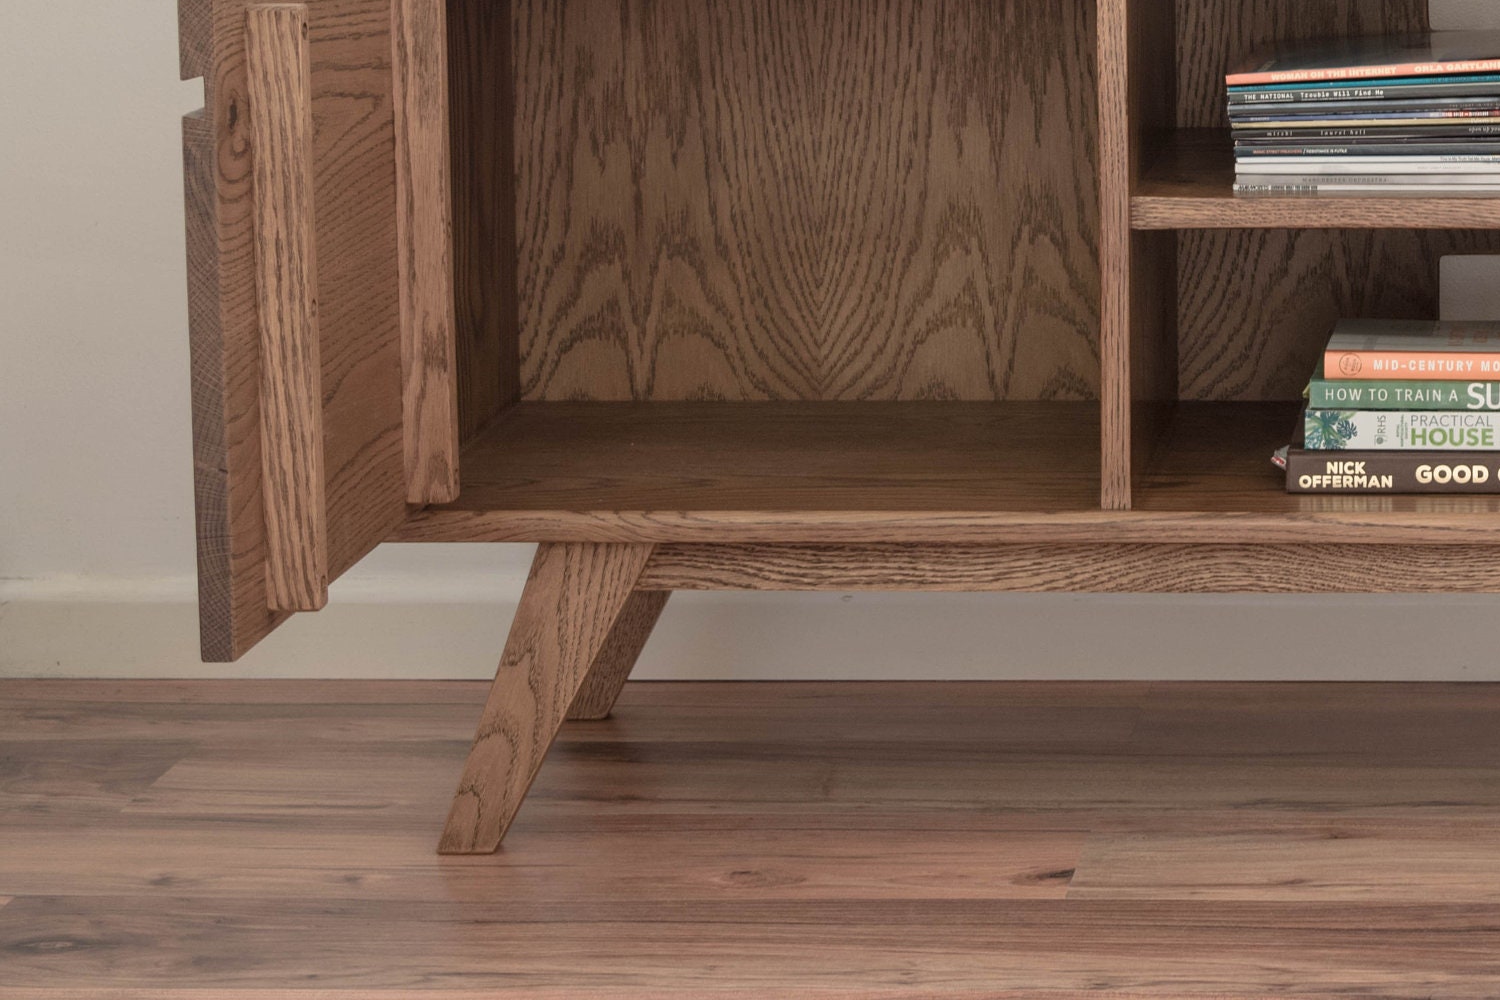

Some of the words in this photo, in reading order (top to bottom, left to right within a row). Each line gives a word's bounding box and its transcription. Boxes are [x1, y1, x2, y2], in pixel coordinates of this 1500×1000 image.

[1271, 72, 1308, 81] WOMAN
[1310, 71, 1324, 79] ON
[1326, 69, 1346, 78] THE
[1349, 66, 1397, 77] INTERNET
[1414, 64, 1444, 73] ORLA
[1375, 88, 1384, 96] Me
[1373, 359, 1474, 373] MID-CENTURY
[1325, 388, 1362, 401] HOW
[1368, 388, 1388, 401] TO
[1394, 388, 1442, 402] TRAIN
[1448, 389, 1459, 402] A
[1377, 415, 1387, 434] RHS
[1410, 414, 1493, 427] PRACTICAL
[1410, 428, 1494, 447] HOUSE
[1326, 461, 1366, 475] NICK
[1415, 464, 1489, 484] GOOD
[1298, 475, 1393, 489] OFFERMAN
